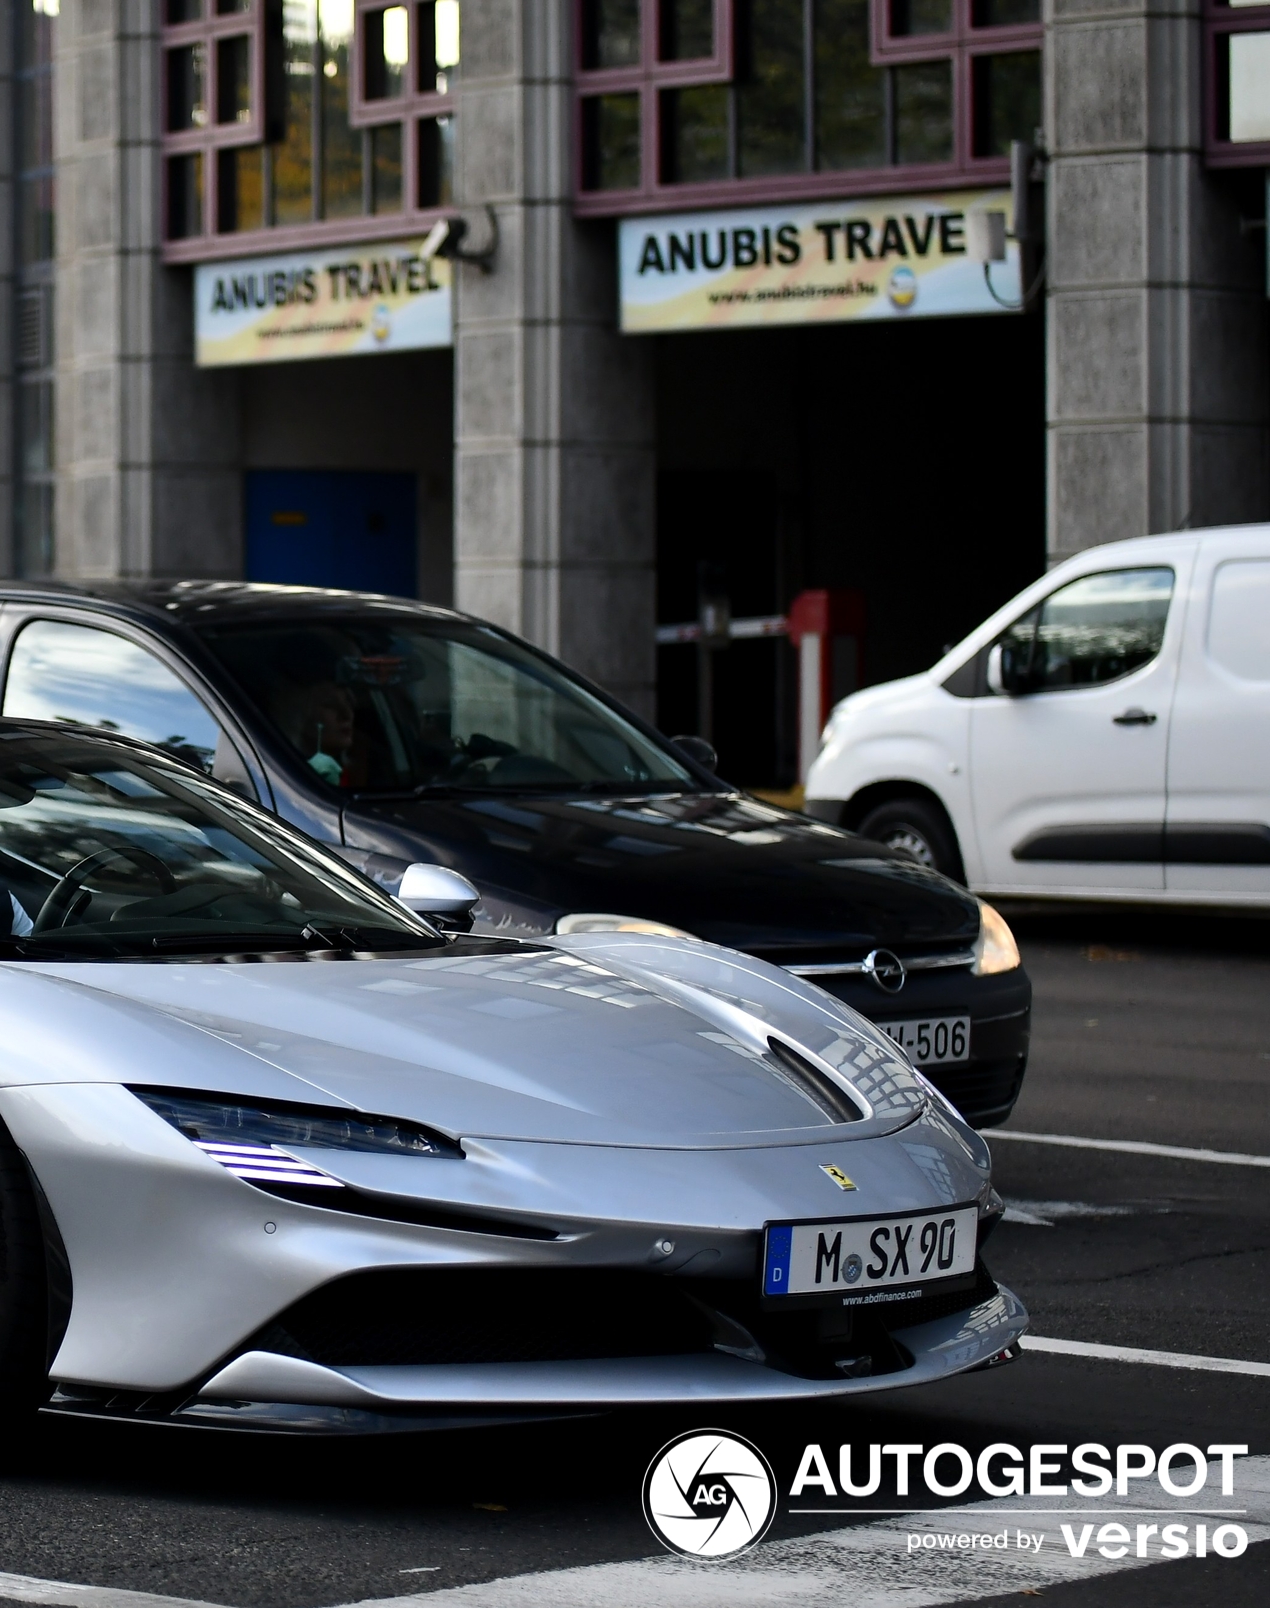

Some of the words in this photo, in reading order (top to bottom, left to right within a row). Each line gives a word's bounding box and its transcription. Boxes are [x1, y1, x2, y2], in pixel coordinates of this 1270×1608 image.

[638, 222, 801, 276] ANUBIS
[815, 212, 966, 262] TRAVE
[212, 266, 317, 313] ANUBIS
[327, 255, 441, 302] TRAVEL
[772, 1267, 782, 1282] D
[815, 1231, 842, 1284] M
[842, 1288, 922, 1306] www.abdfinance.com
